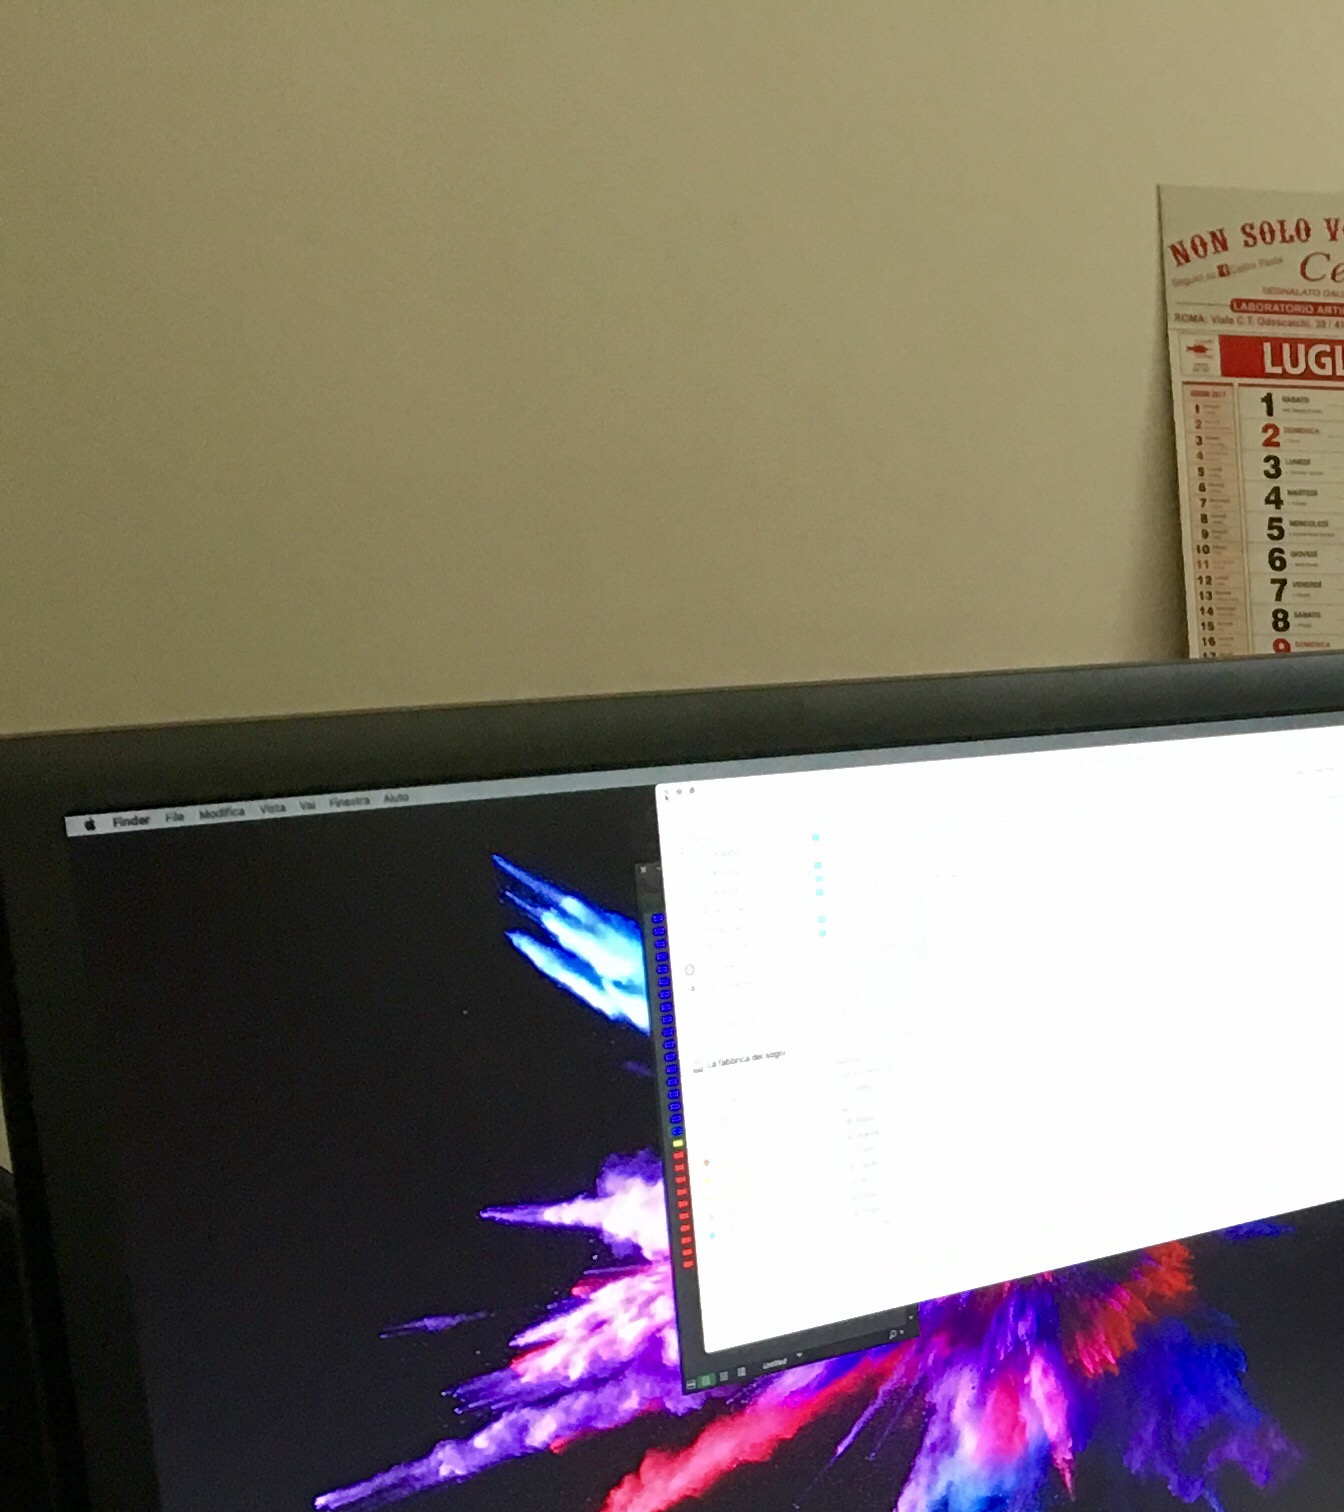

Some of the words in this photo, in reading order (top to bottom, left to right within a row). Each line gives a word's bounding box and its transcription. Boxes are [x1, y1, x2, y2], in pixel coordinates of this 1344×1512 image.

[1169, 227, 1229, 268] NON
[1240, 217, 1312, 248] SOLO
[1262, 286, 1321, 297] SEGNALATO
[1233, 301, 1314, 314] LABORATORIO
[1261, 392, 1274, 417] 1
[1262, 423, 1281, 448] 2
[1263, 455, 1282, 479] 3
[1199, 498, 1207, 508] 7
[1264, 486, 1284, 510] 4
[1267, 516, 1285, 541] 5
[1196, 544, 1210, 555] 10
[1268, 547, 1287, 572] 6
[1270, 578, 1288, 602] 7
[1271, 608, 1290, 632] 8
[112, 815, 150, 828] Finder
[165, 811, 185, 823] File
[199, 805, 246, 819] Modifica
[259, 803, 286, 814] Vista
